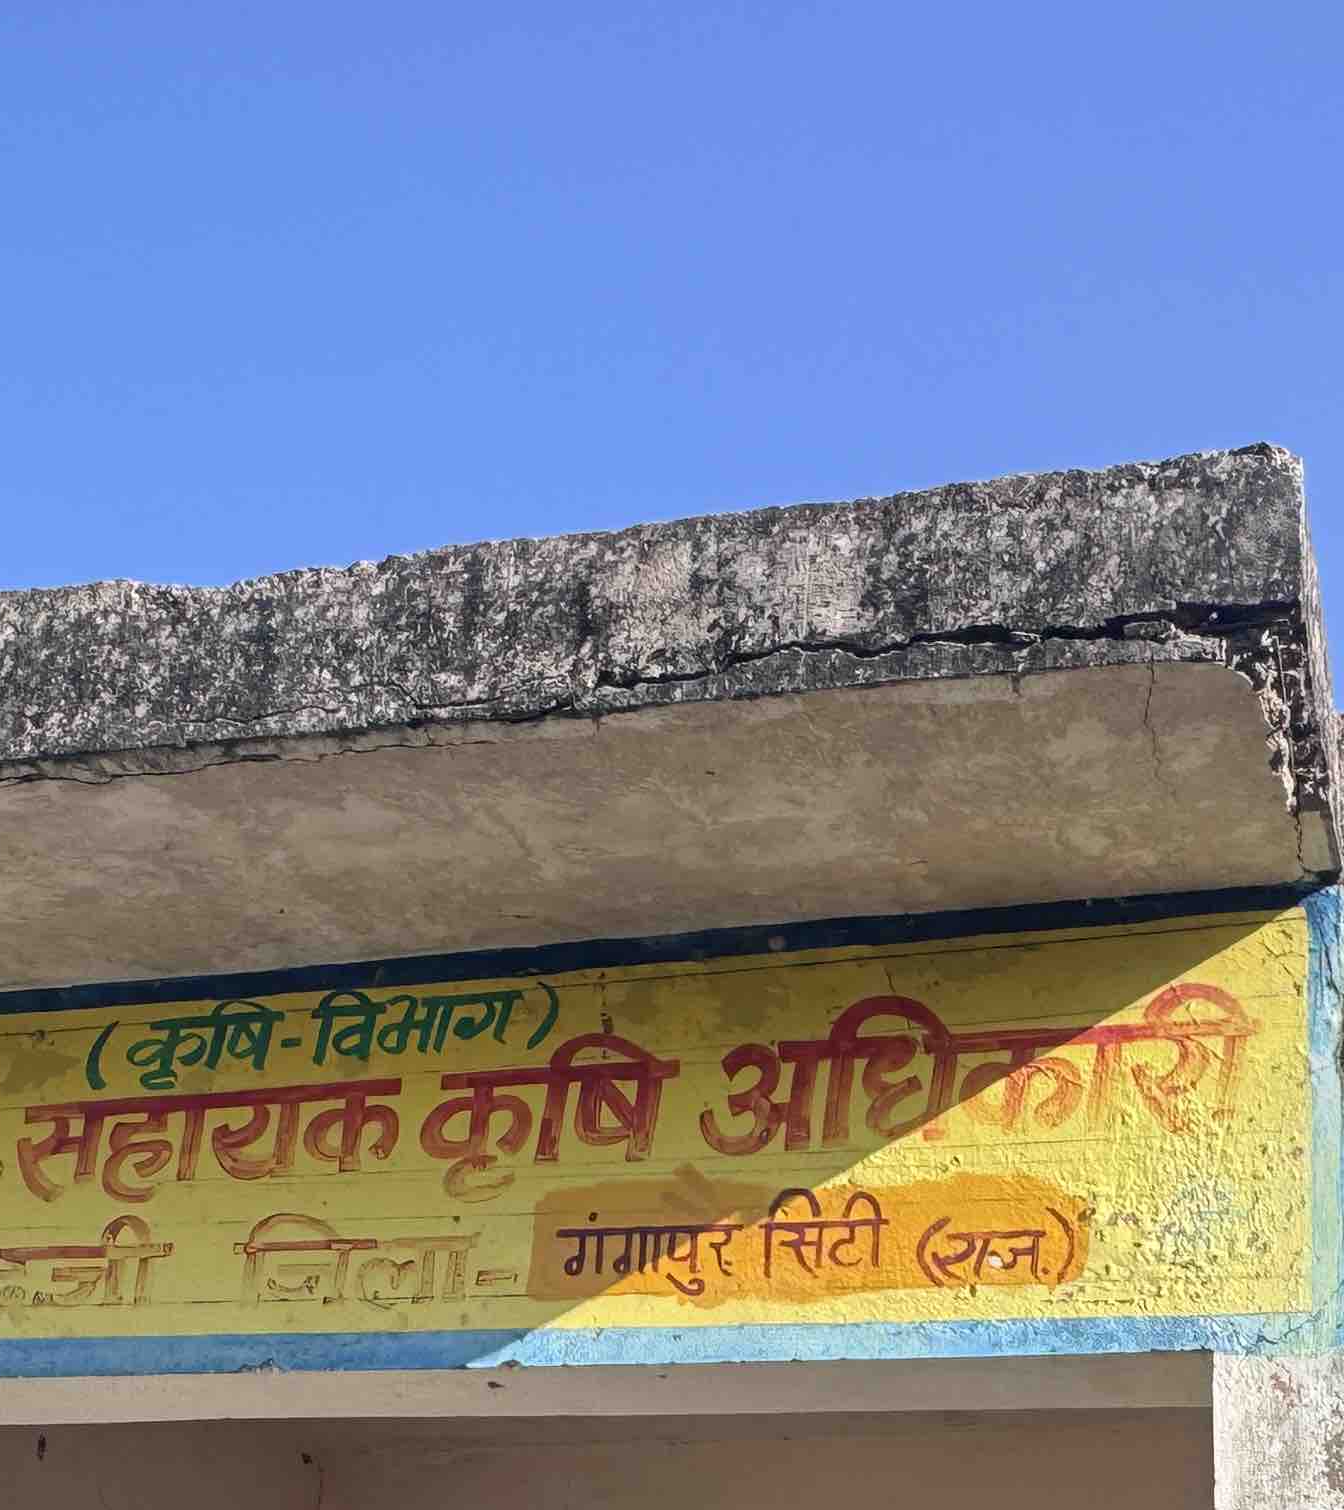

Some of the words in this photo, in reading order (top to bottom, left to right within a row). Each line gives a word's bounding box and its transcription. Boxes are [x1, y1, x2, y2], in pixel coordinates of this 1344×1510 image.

[16, 1077, 402, 1202] सहायक
[419, 1030, 681, 1201] कृषि
[700, 982, 1260, 1156] अधिकारी
[557, 1211, 745, 1297] गंगापुर
[759, 1187, 889, 1278] सिटी
